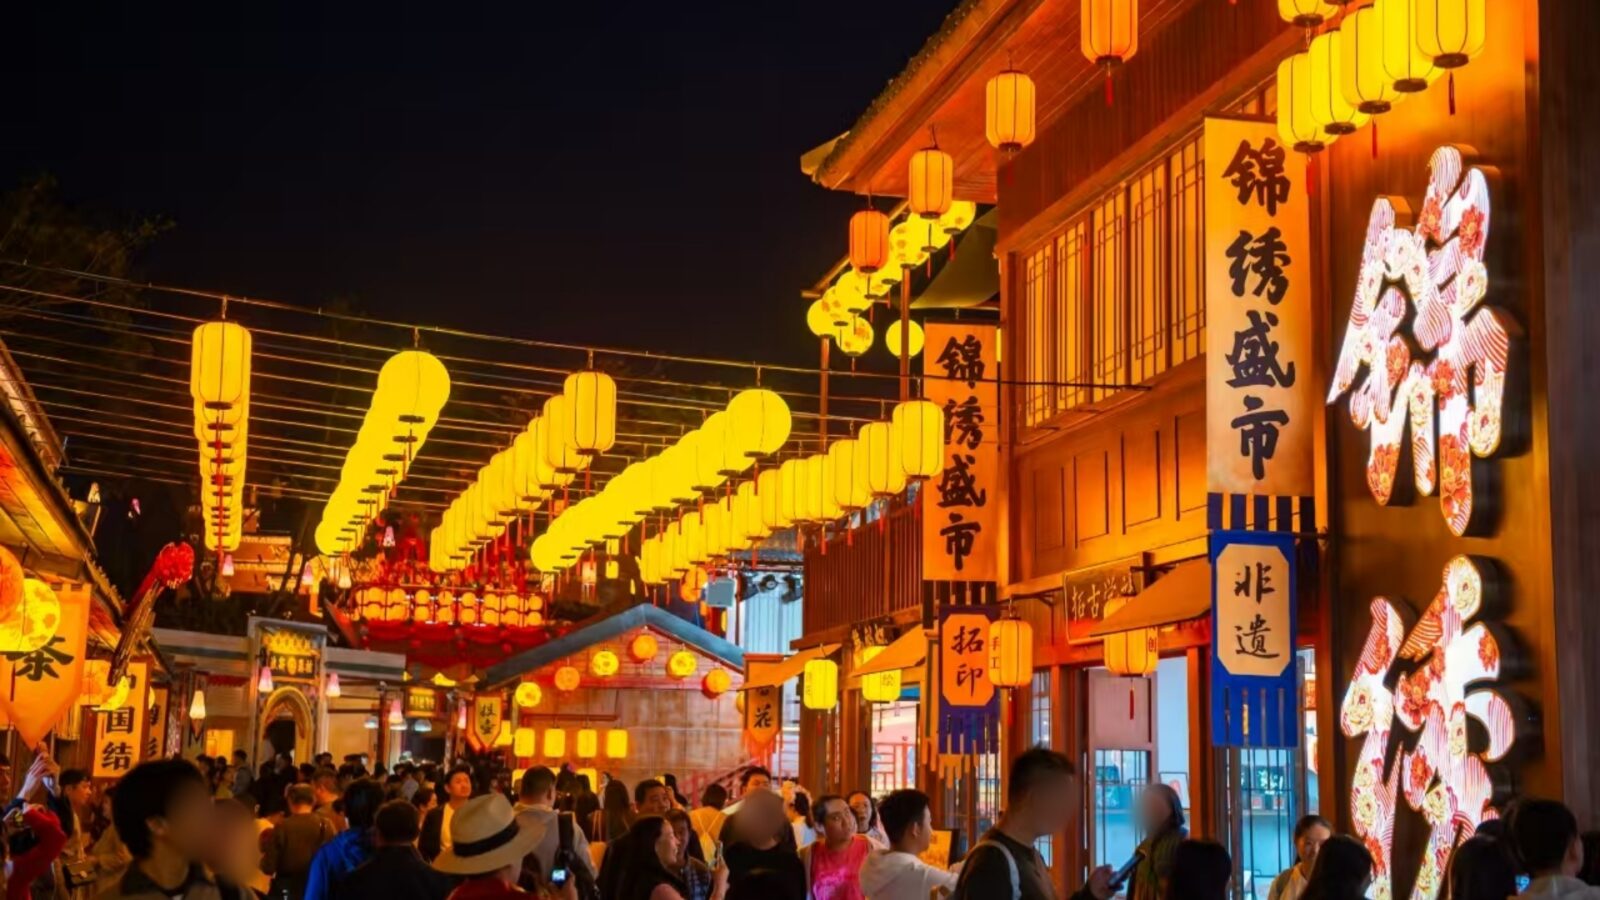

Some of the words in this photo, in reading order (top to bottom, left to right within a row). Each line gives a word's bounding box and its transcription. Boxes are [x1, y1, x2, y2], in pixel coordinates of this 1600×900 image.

[1222, 137, 1295, 480] 锦绣盛市
[936, 334, 986, 571] 锦绣盛市
[6, 635, 75, 681] 茶
[1234, 561, 1280, 659] 非遗
[754, 687, 772, 729] 花
[951, 625, 984, 697] 拓印
[101, 674, 137, 770] 国结
